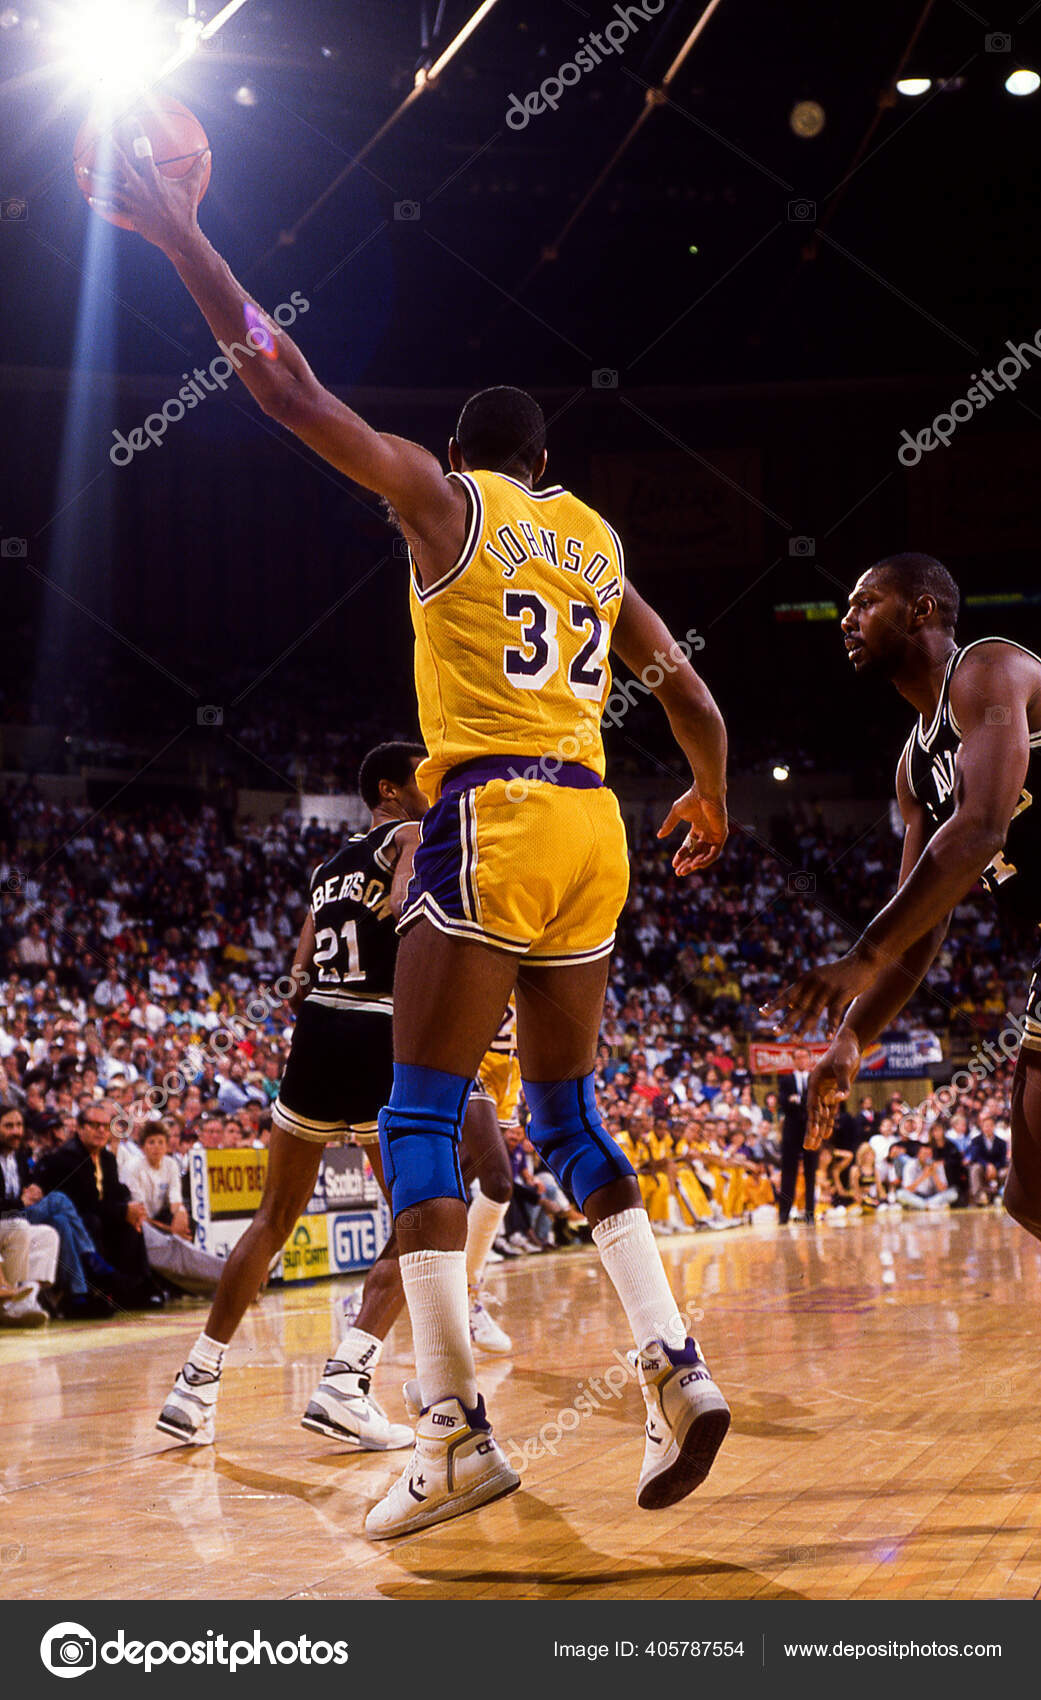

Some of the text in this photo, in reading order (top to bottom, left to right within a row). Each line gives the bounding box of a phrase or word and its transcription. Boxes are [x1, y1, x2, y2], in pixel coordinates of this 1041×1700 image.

[485, 519, 623, 608] JOHNSON
[503, 588, 611, 702] 32
[313, 919, 366, 983] 21
[207, 1165, 266, 1194] TACO BE
[324, 1165, 363, 1198] Scotch
[335, 1220, 376, 1263] GTE
[431, 1412, 459, 1428] CONS
